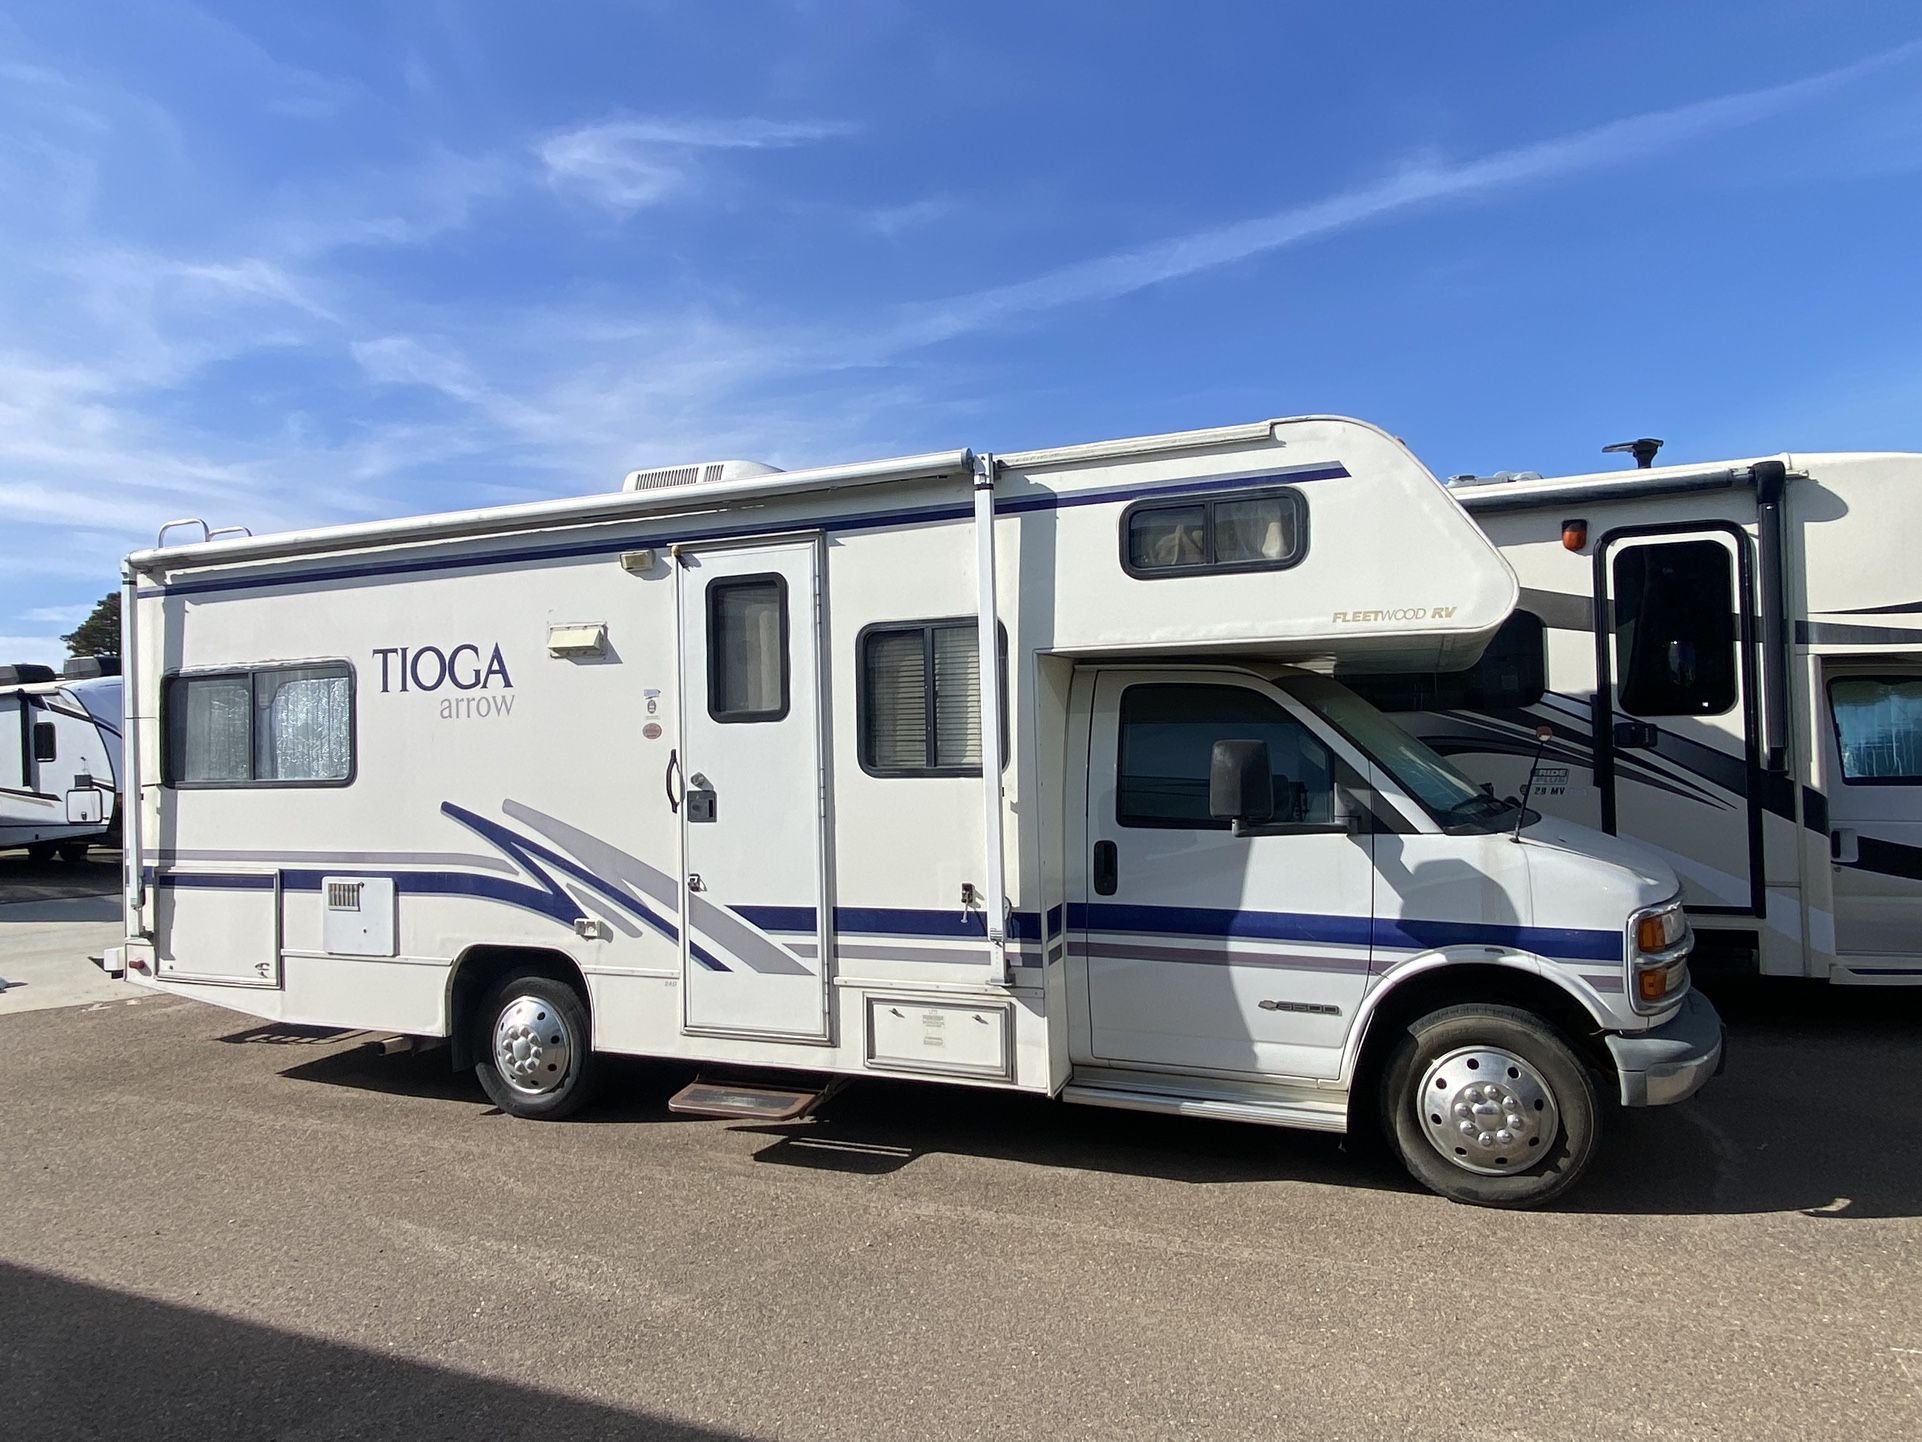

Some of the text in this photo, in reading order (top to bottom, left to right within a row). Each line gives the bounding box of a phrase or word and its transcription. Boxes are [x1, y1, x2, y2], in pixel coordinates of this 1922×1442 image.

[1332, 606, 1457, 623] FLEETWOOD RV
[372, 641, 514, 693] TIOGA
[439, 694, 516, 720] arrow
[1550, 786, 1566, 795] MV
